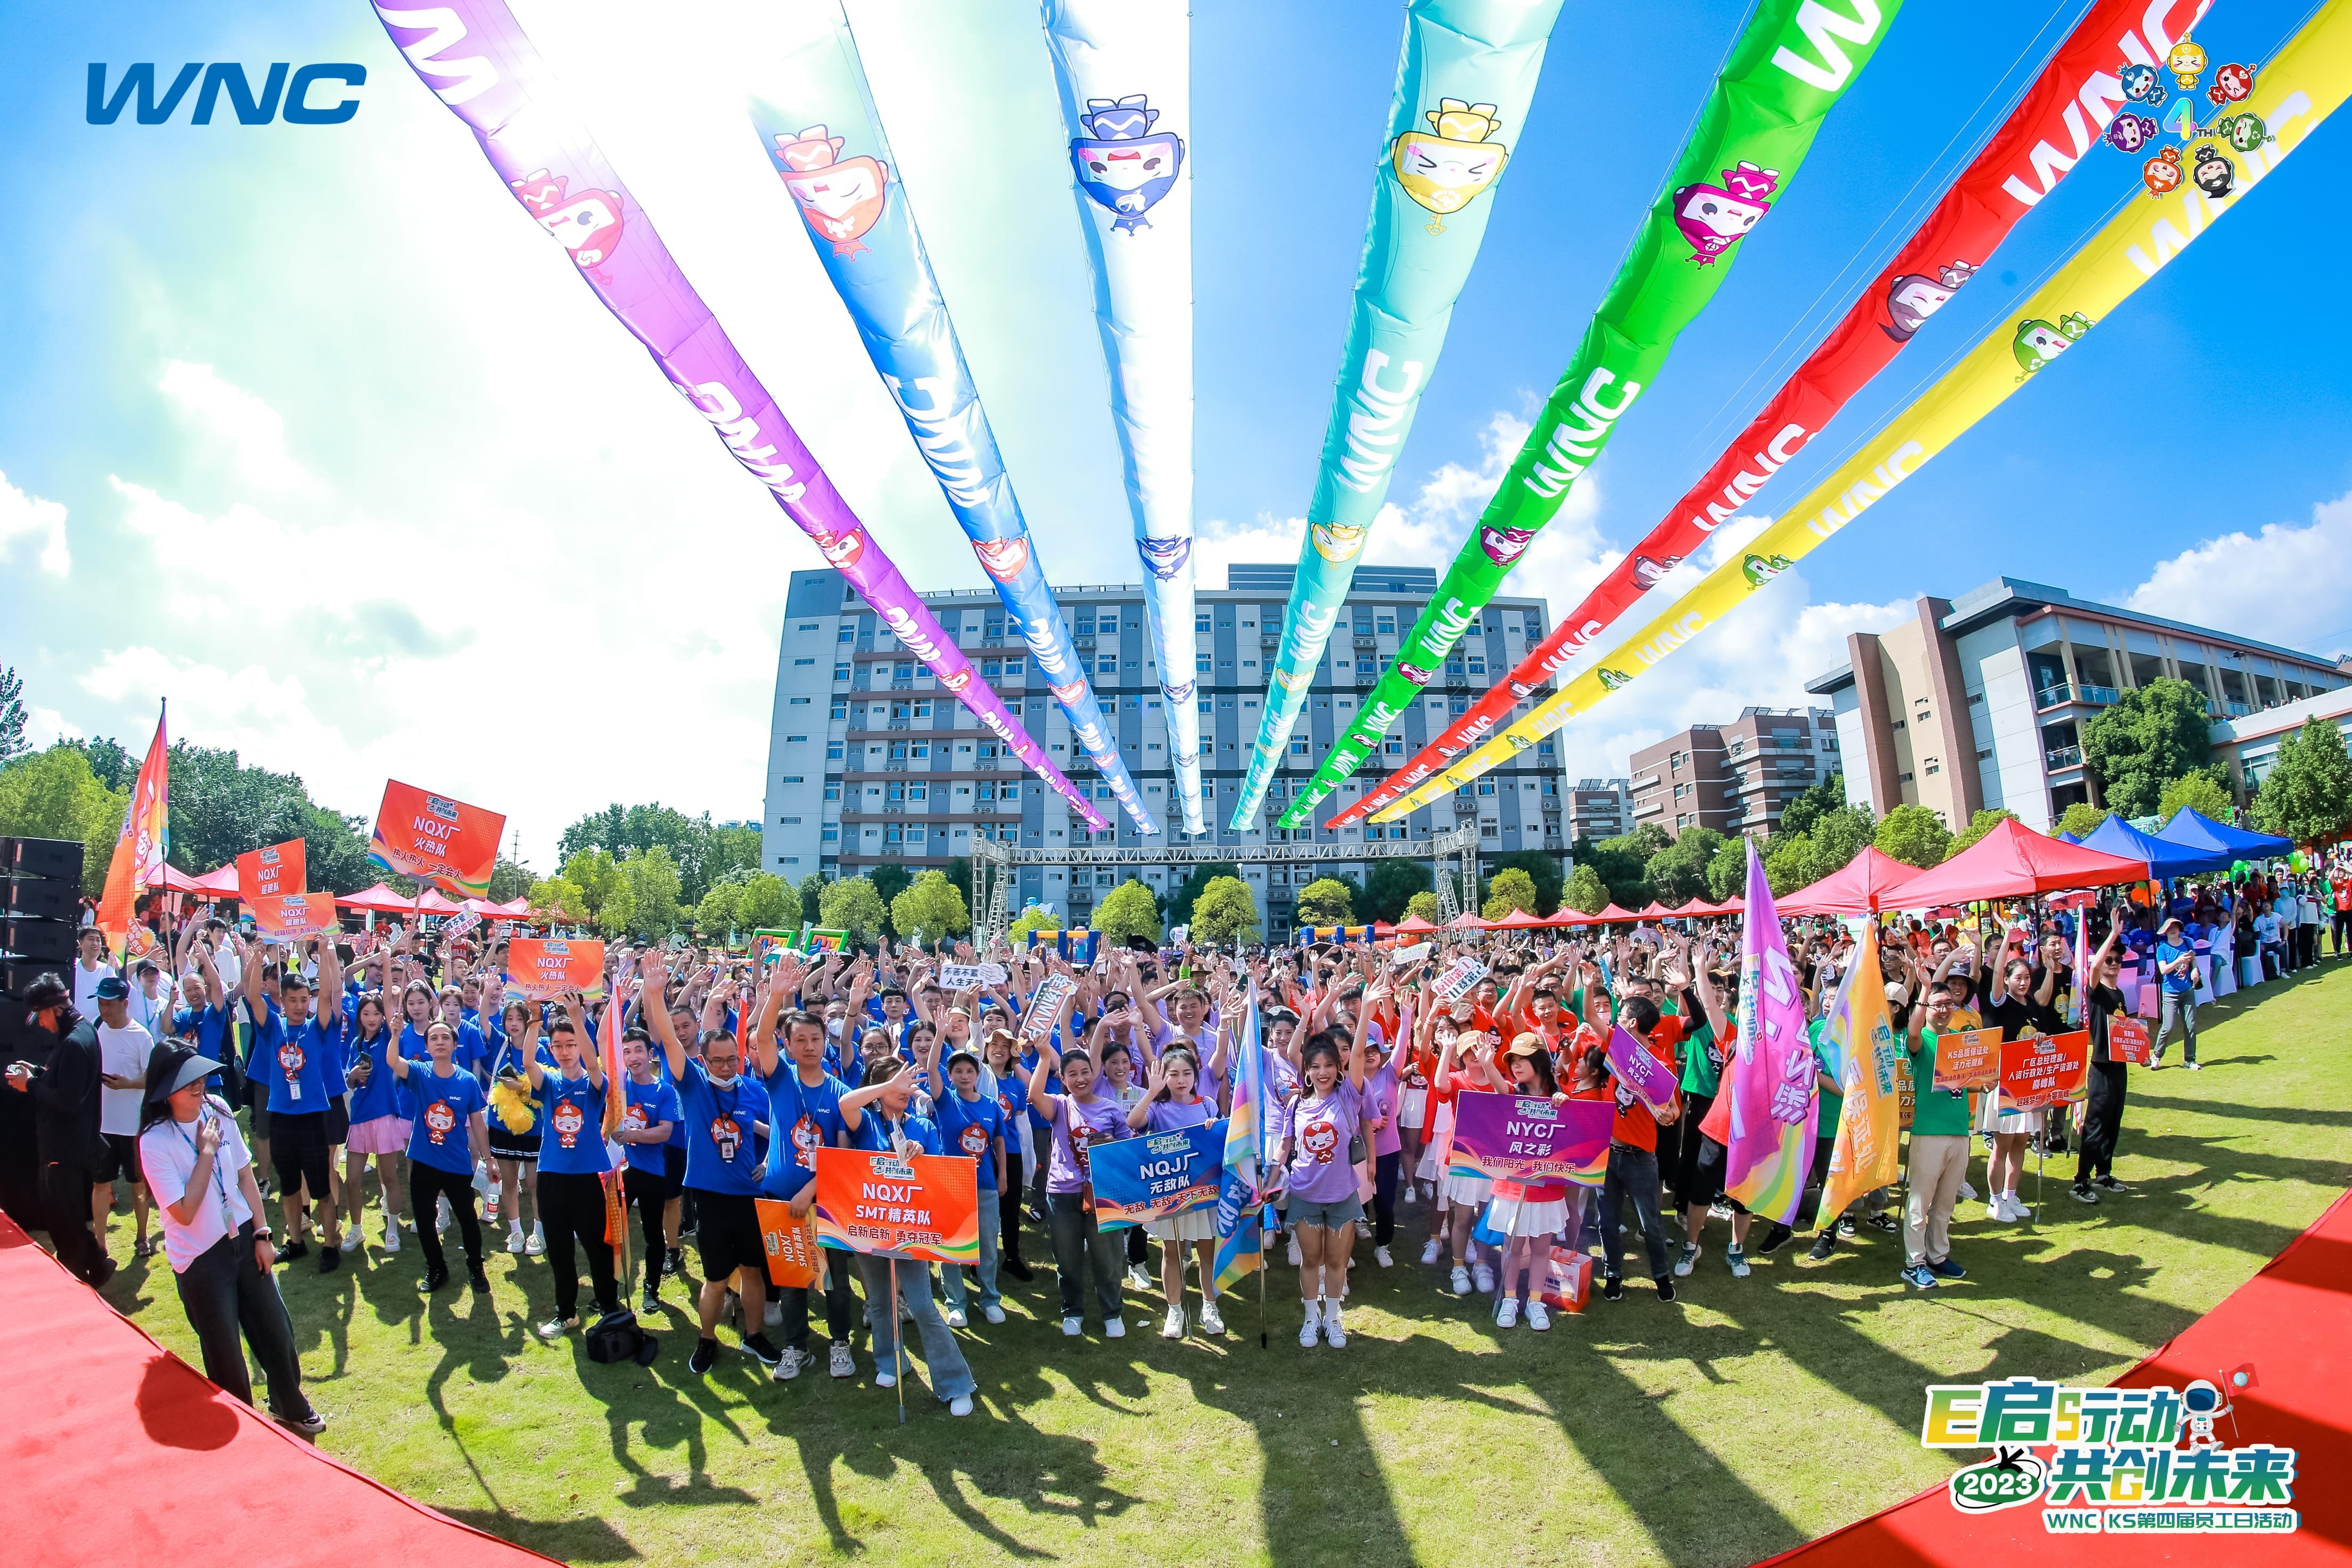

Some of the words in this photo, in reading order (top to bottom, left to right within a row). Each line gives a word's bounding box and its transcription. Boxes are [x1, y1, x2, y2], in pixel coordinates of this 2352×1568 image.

[1336, 348, 1423, 494] WNC
[1524, 367, 1641, 498] WNC
[1692, 423, 1818, 533] WNC
[1807, 440, 1935, 538] WNC
[1288, 600, 1337, 662] WNC
[1420, 597, 1483, 657] WNC
[1541, 619, 1603, 672] WNC
[1635, 612, 1716, 665] WNC
[413, 816, 461, 840] NQX厂
[414, 837, 447, 857] 火热队
[258, 864, 283, 882] NQX厂
[392, 848, 425, 868] 热火热火
[429, 862, 463, 880] 一定会火
[281, 907, 311, 917] NQX厂
[537, 957, 574, 969] NQX厂
[540, 971, 566, 980] 火热队
[1948, 1045, 1989, 1060] KS品质保证处
[2022, 1053, 2067, 1068] 厂区总经理室/
[1629, 1054, 1654, 1077] NYC厂
[1952, 1058, 1983, 1070] 活力无限队
[2008, 1061, 2079, 1081] 人资行政处/生产资源处
[1628, 1067, 1646, 1086] 风之彩
[2016, 1095, 2041, 1106] 超越梦想
[1506, 1121, 1566, 1140] NYC厂
[1509, 1141, 1552, 1157] 风之彩
[1140, 1152, 1199, 1180] NQJ厂
[1482, 1156, 1526, 1170] 我们阳光
[1532, 1160, 1576, 1174] 我们快乐
[862, 1183, 923, 1204] NQX厂
[1150, 1175, 1190, 1195] 无敌队
[1124, 1201, 1146, 1215] 无敌
[1150, 1194, 1172, 1209] 无敌
[1177, 1185, 1220, 1204] 天下无敌
[855, 1205, 931, 1226] SMT精英队
[778, 1229, 795, 1262] NQX厂
[847, 1225, 891, 1241] 启新启新
[896, 1230, 942, 1246] 勇夺冠军
